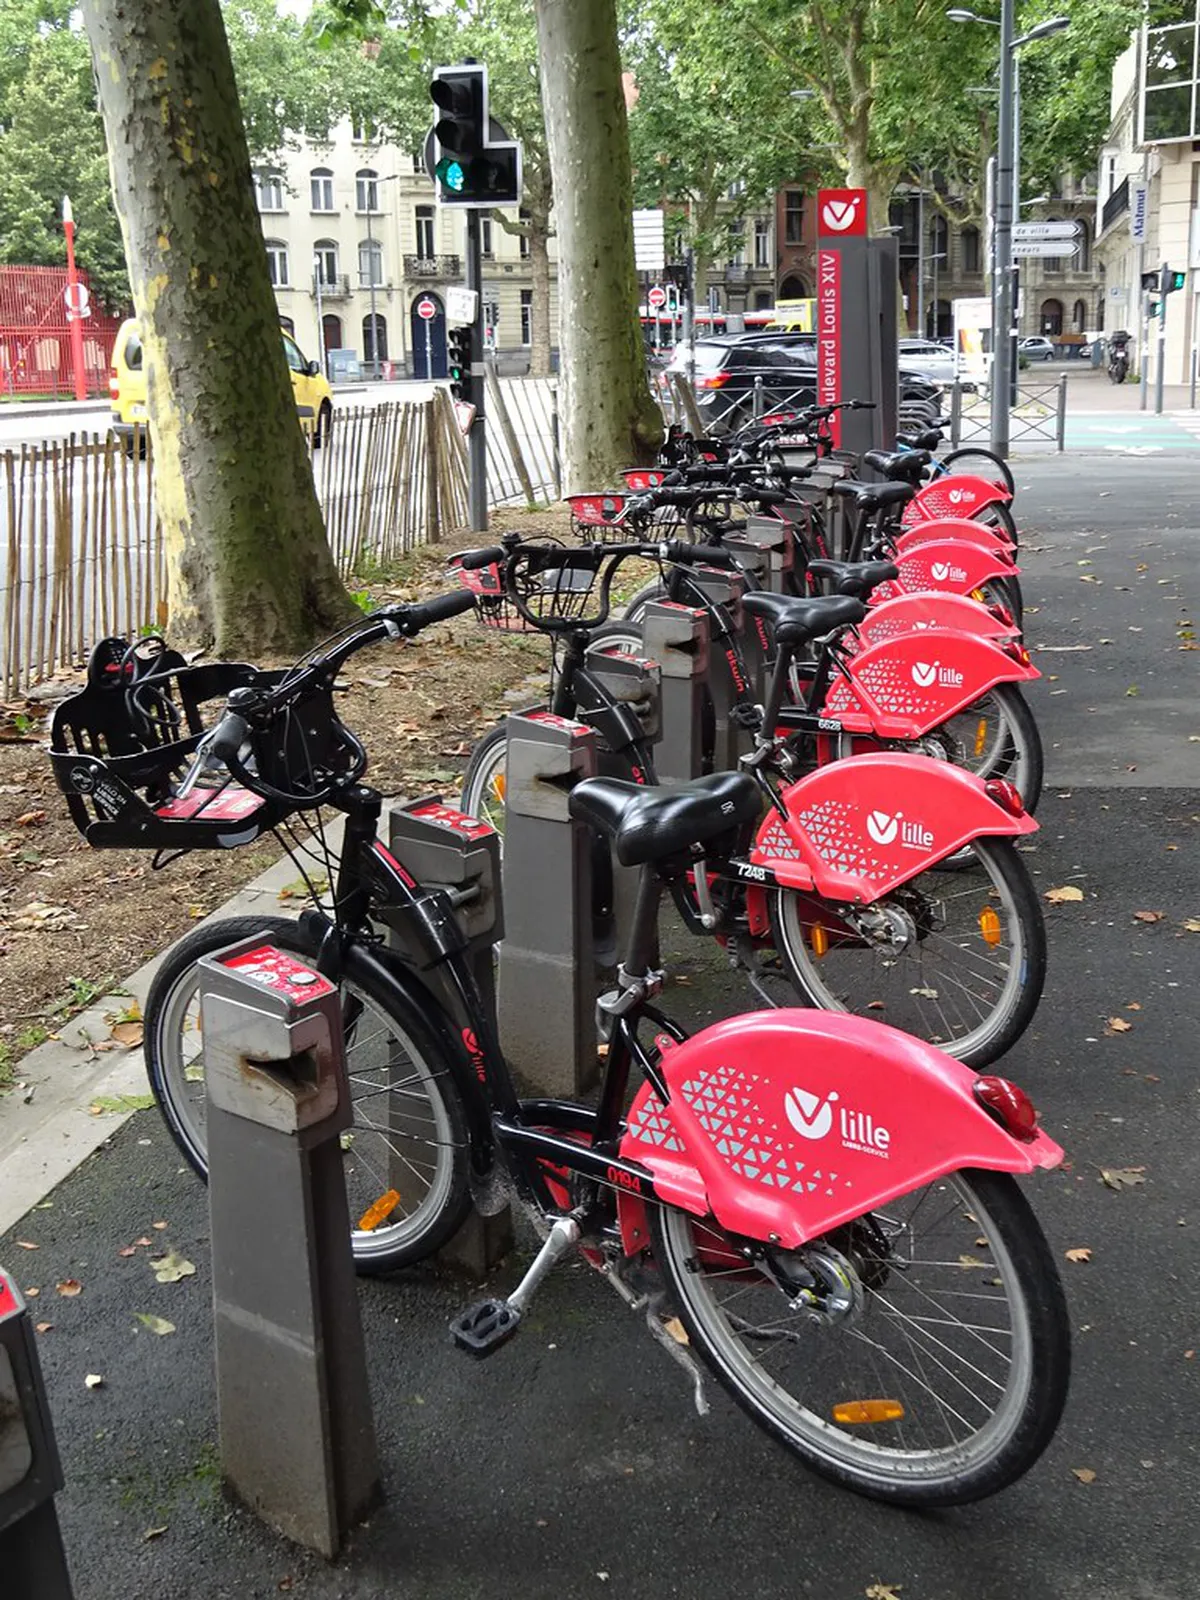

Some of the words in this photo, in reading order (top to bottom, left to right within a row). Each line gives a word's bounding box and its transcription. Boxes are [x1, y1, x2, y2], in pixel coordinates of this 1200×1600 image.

[1133, 188, 1146, 238] Matmut
[821, 253, 836, 284] XIV
[821, 288, 836, 334] Louis
[821, 343, 836, 423] Bulevard
[938, 666, 964, 684] lille
[902, 821, 934, 847] lille
[840, 1108, 890, 1149] lille
[607, 1165, 641, 1193] 0194
